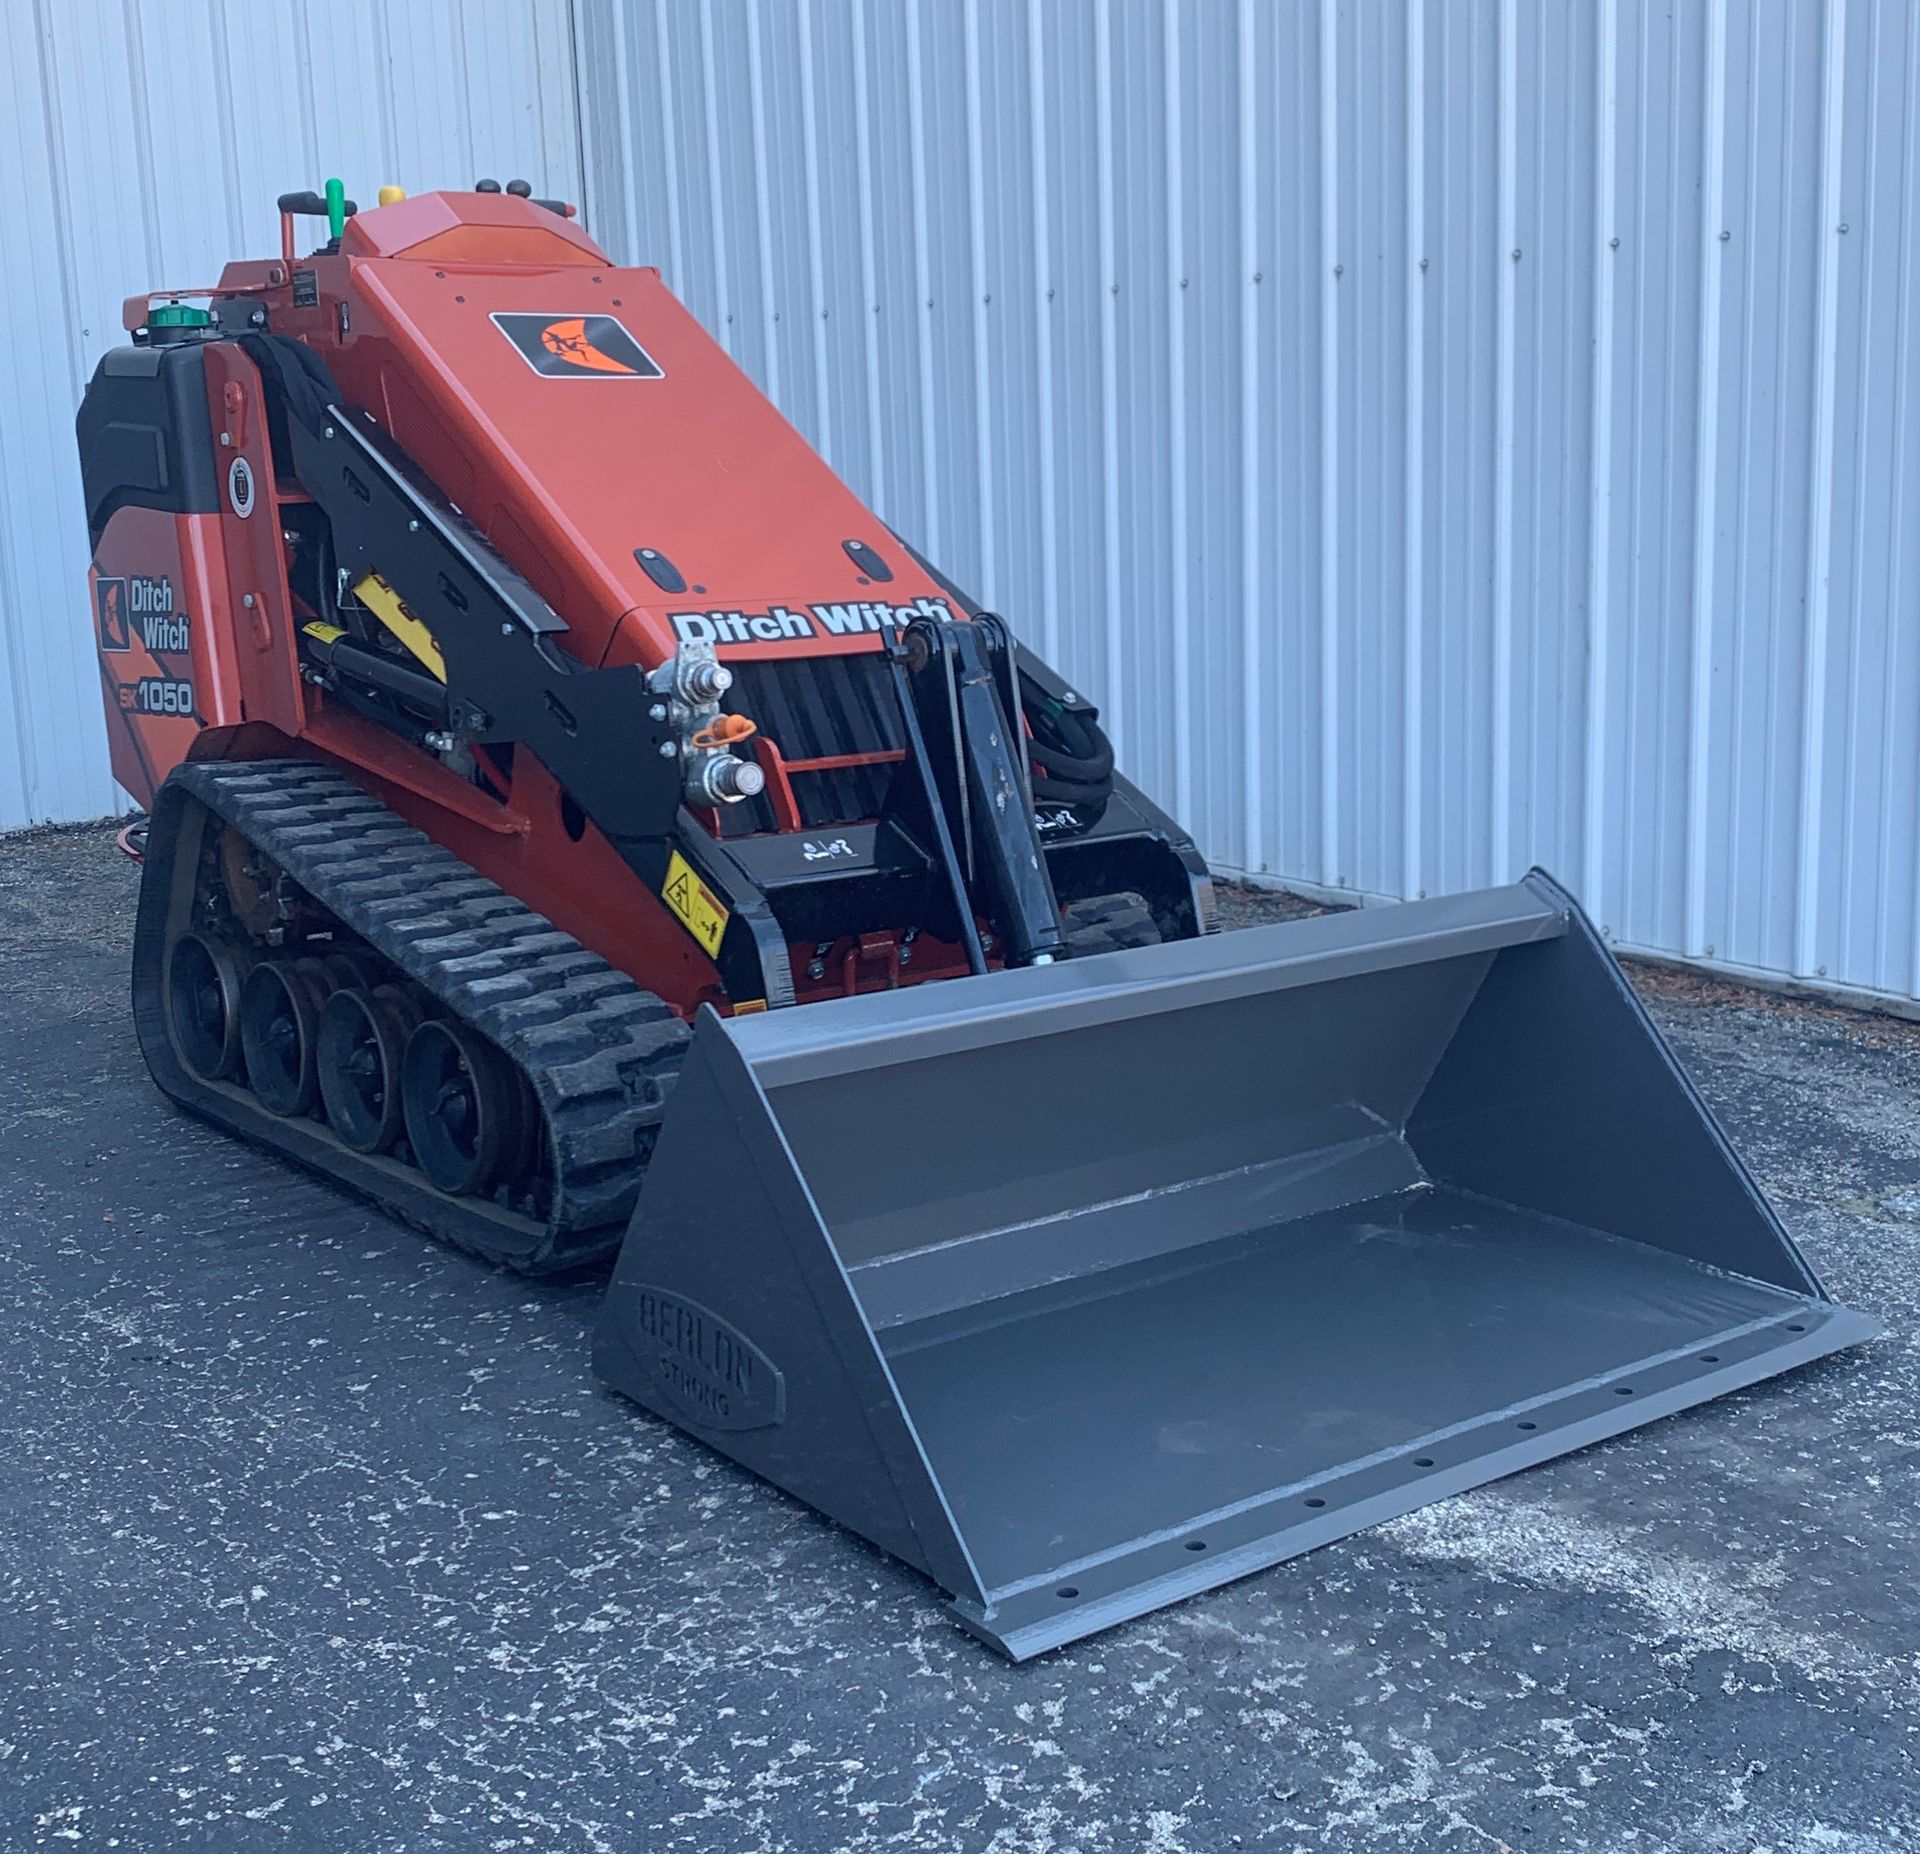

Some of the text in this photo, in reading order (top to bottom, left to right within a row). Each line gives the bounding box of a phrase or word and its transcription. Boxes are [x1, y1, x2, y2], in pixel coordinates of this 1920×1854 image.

[131, 579, 172, 612] Ditch
[143, 616, 189, 650] Witch
[672, 599, 952, 643] Ditch Witch
[659, 1357, 730, 1416] STRONG
